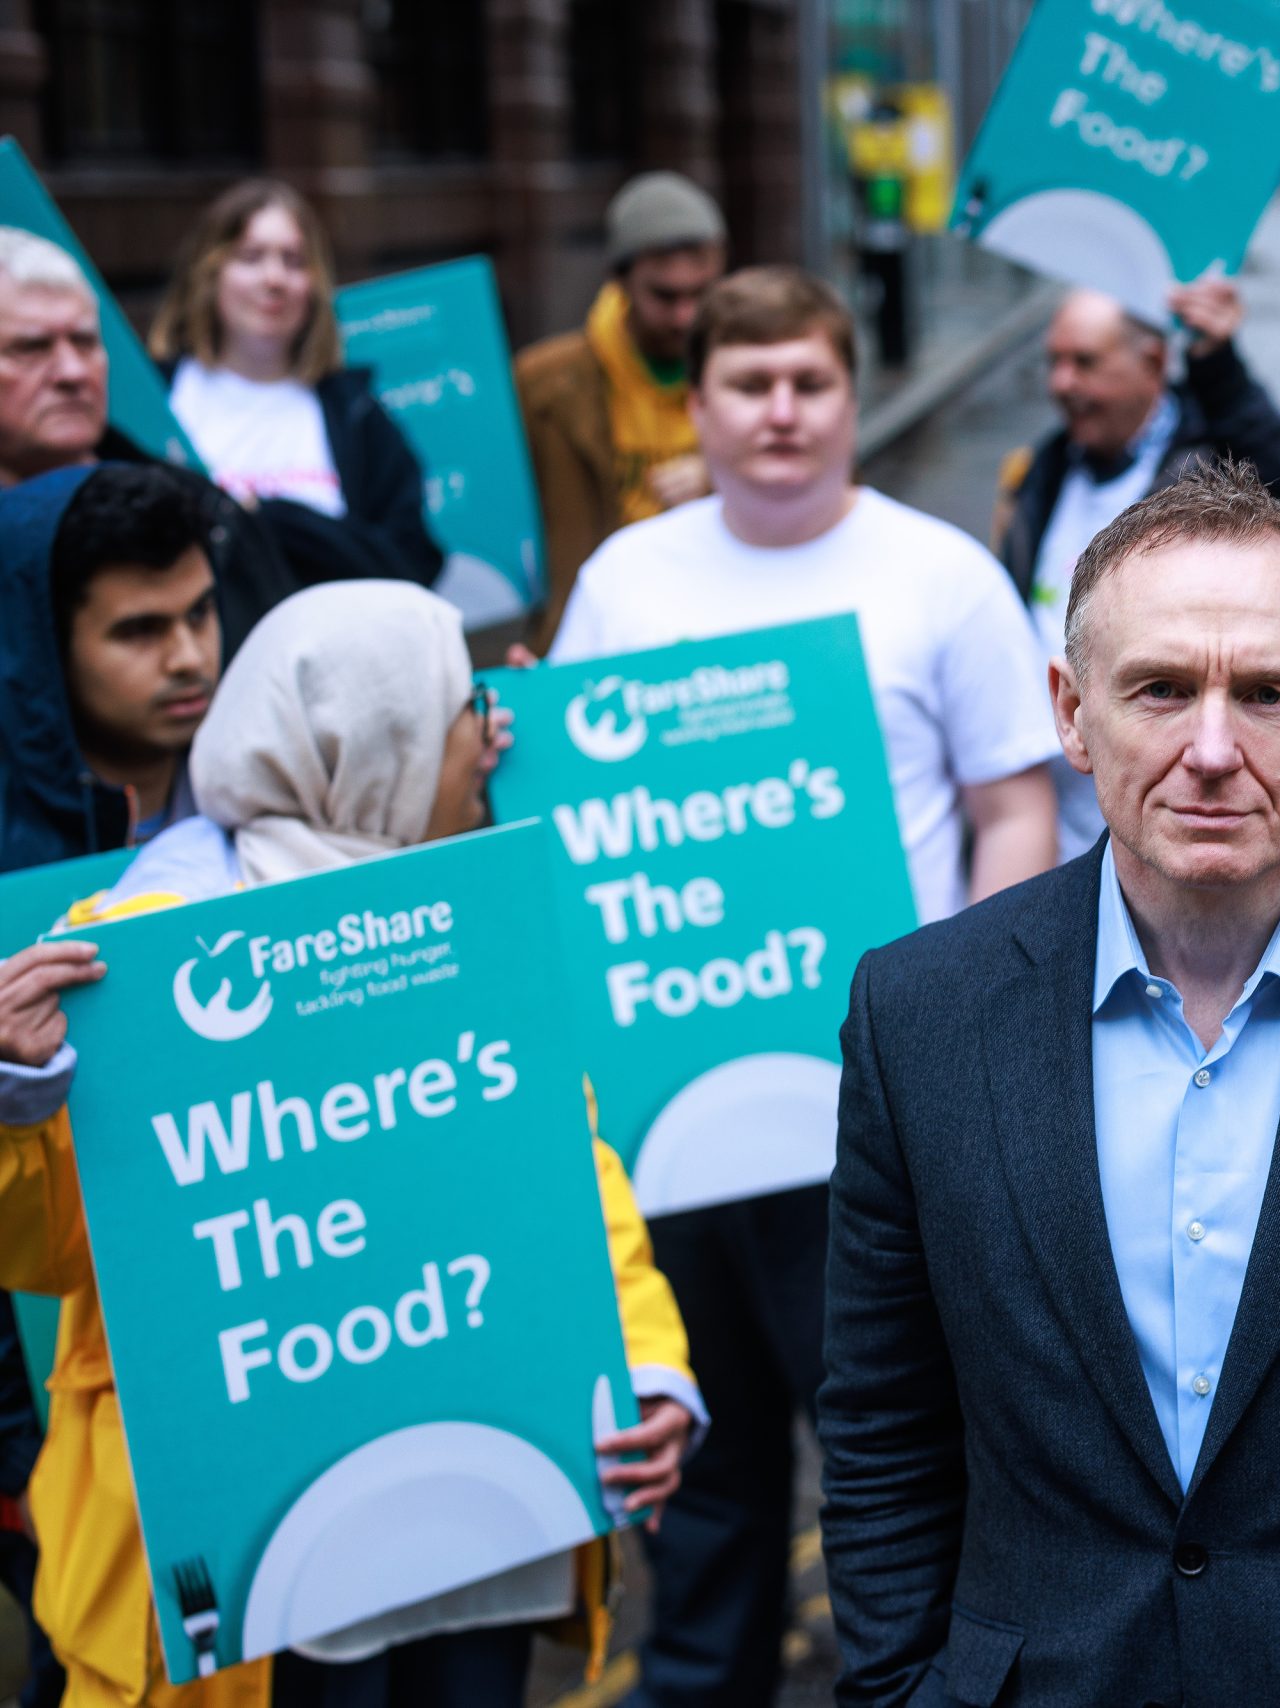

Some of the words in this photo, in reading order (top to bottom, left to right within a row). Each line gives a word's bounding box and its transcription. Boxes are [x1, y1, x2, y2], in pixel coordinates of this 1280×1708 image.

[1080, 32, 1167, 104] The
[1050, 88, 1208, 180] Food?
[553, 759, 846, 864] Where's
[248, 900, 453, 979] FareShare
[586, 872, 724, 944] The
[606, 926, 827, 1027] Food?
[151, 1031, 518, 1186] Where's
[193, 1197, 367, 1291] The
[218, 1253, 491, 1404] Food?
